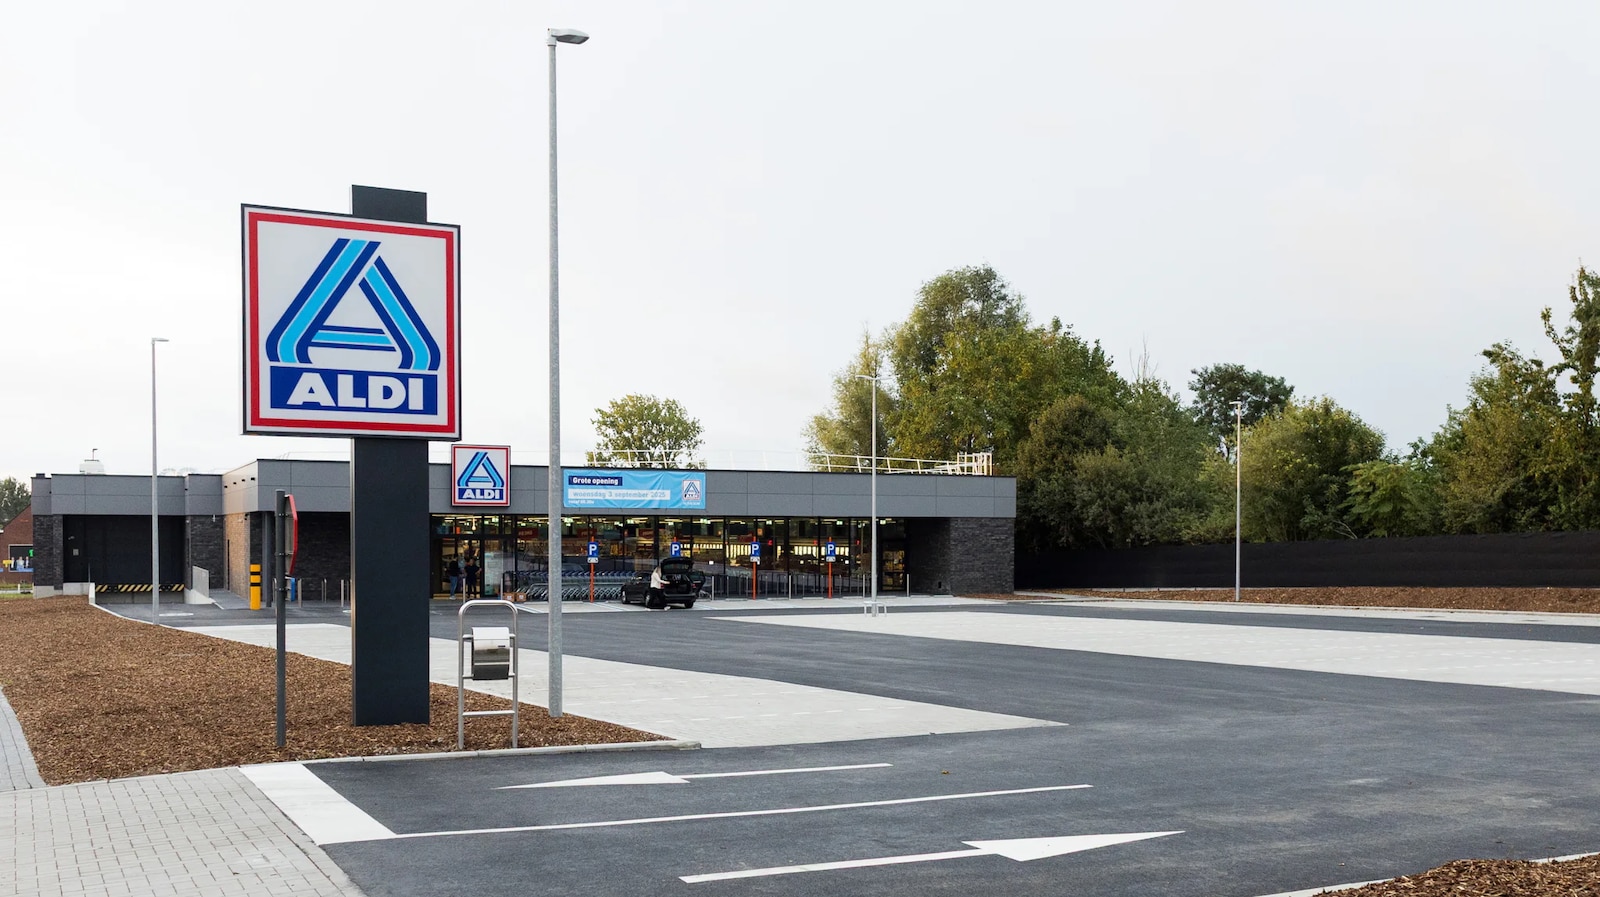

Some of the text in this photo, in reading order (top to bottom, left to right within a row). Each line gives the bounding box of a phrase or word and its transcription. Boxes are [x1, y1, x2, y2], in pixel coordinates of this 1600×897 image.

[286, 372, 424, 410] ALDI
[572, 476, 619, 486] Grote opening
[462, 488, 500, 499] ALDI
[573, 491, 606, 499] woensdag
[614, 491, 648, 499] september
[589, 544, 597, 555] P
[672, 544, 680, 555] P
[752, 543, 759, 555] P
[827, 543, 835, 555] P
